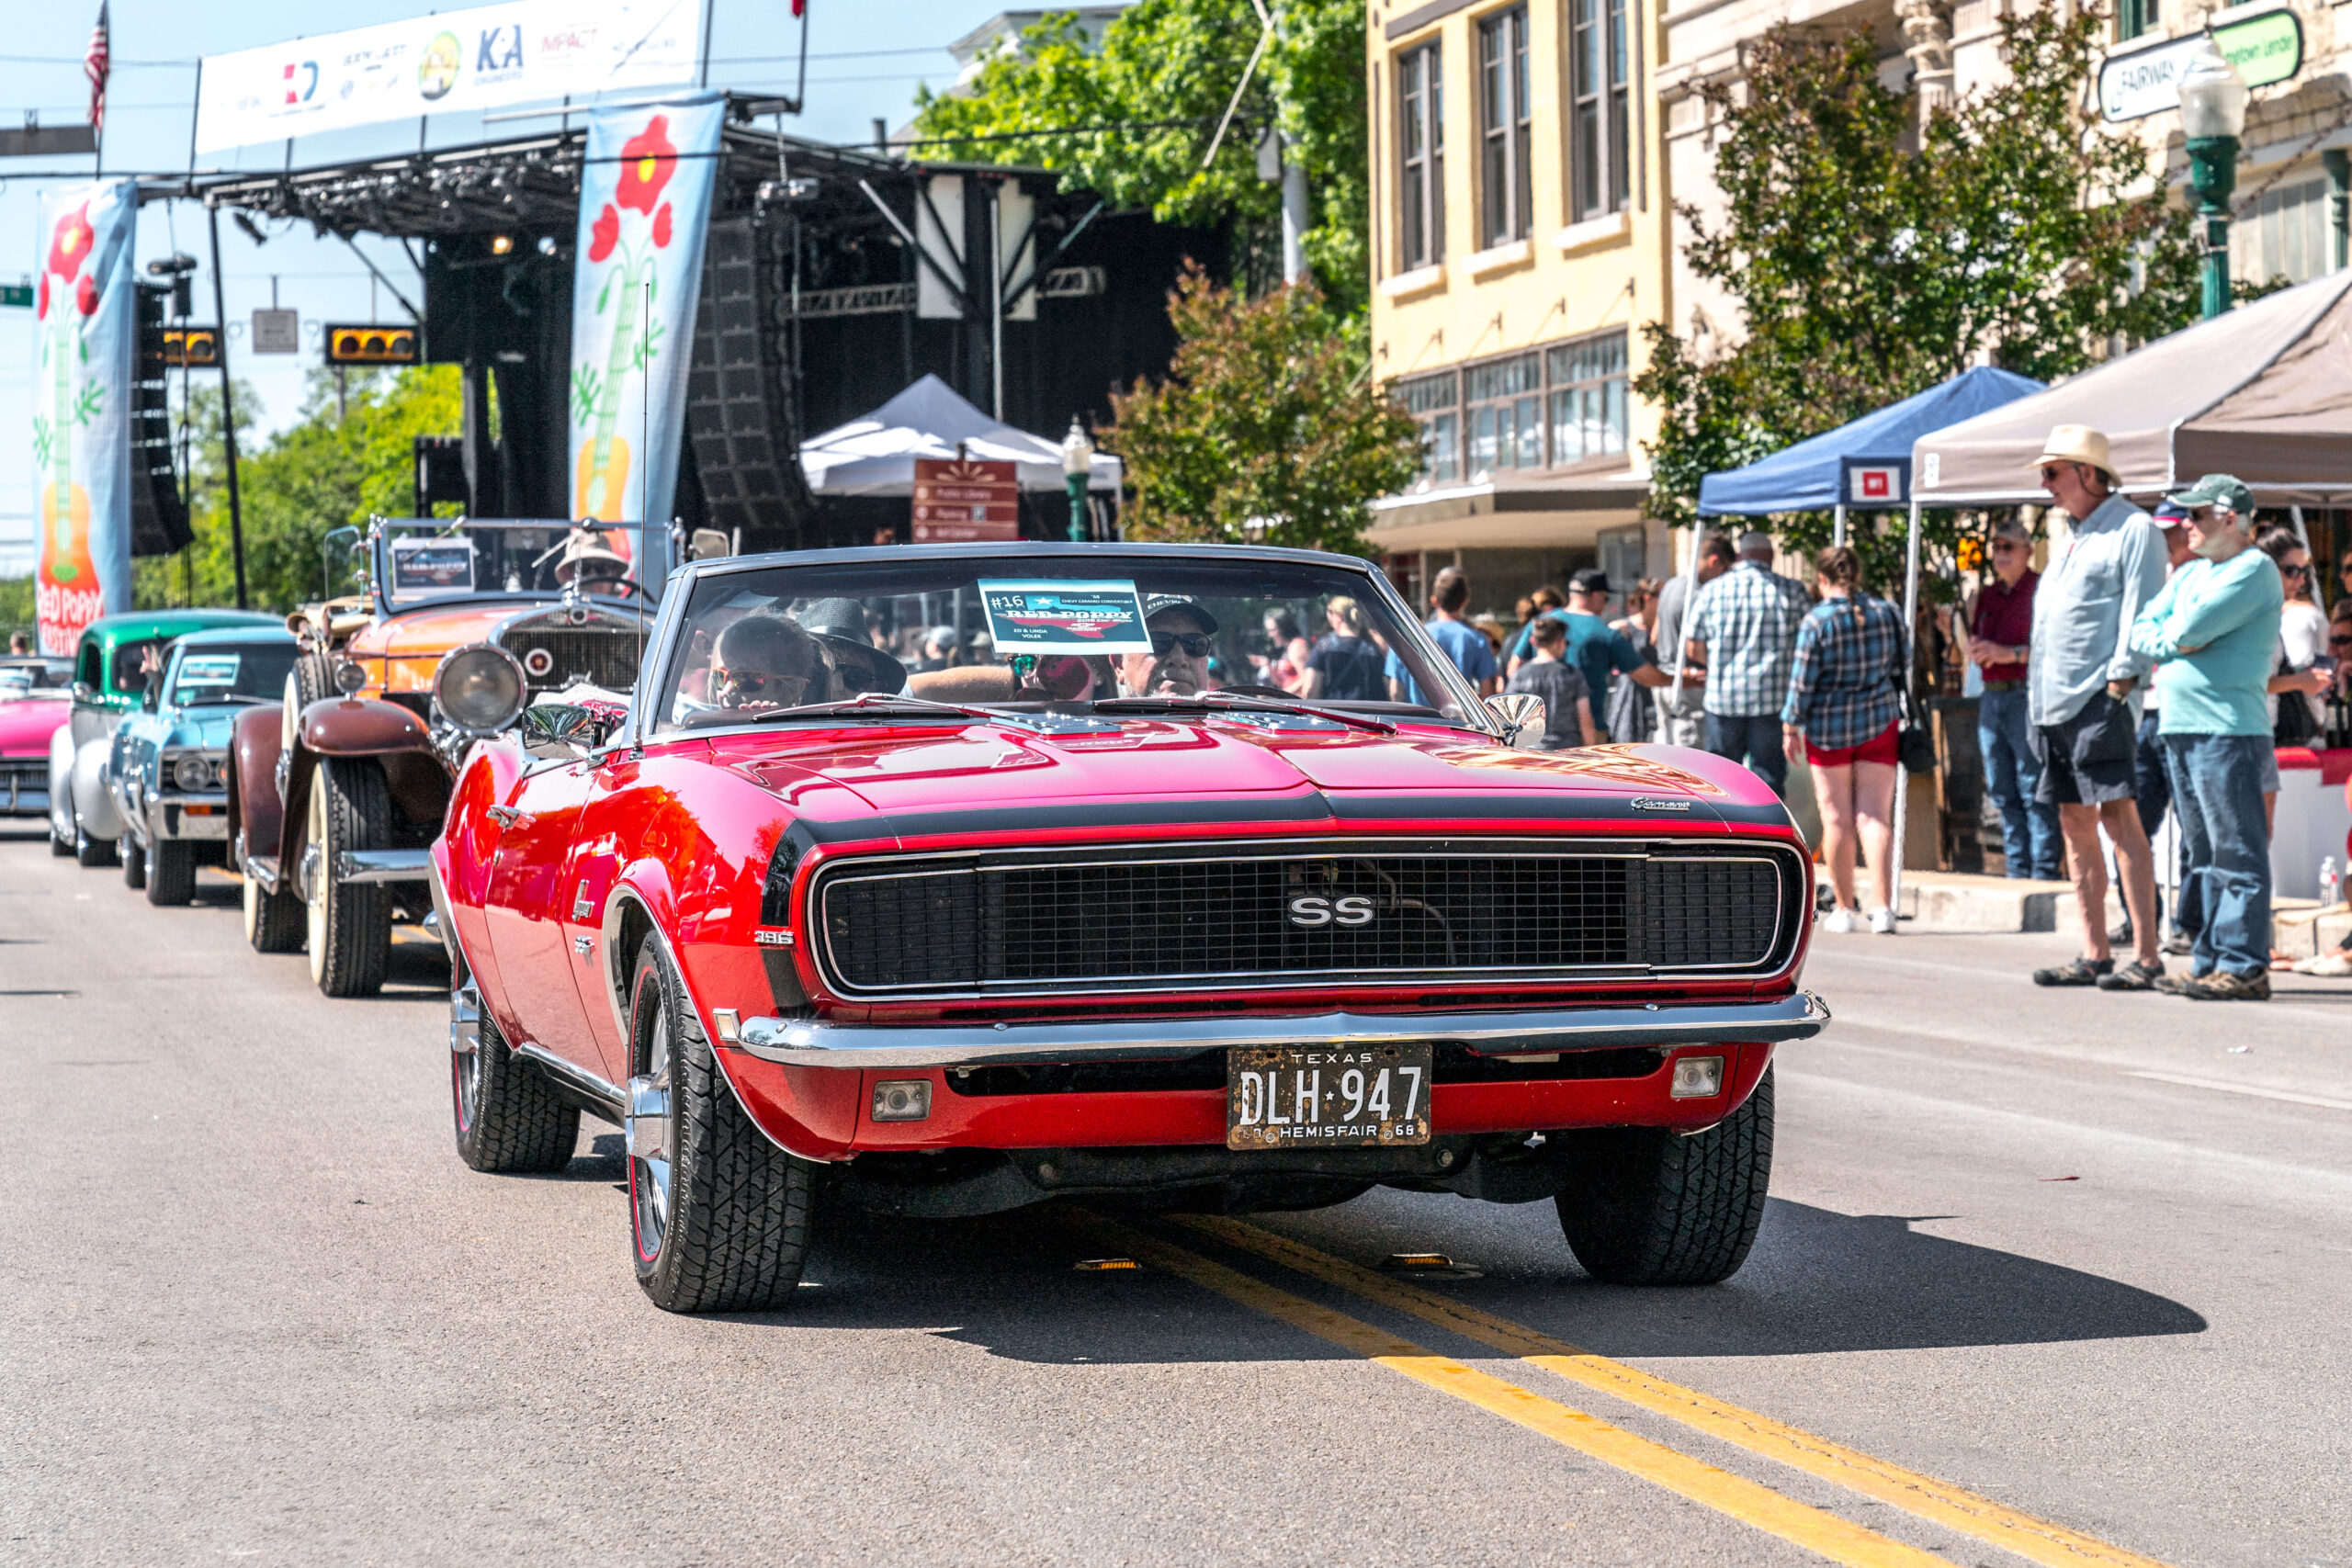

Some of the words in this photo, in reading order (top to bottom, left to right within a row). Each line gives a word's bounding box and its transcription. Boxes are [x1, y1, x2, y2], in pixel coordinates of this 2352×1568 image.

[37, 581, 61, 623] RED
[62, 586, 105, 625] POPPY
[990, 595, 1024, 609] #16
[1004, 610, 1053, 618] RED
[1059, 611, 1134, 619] POPPY
[1630, 796, 1690, 811] Camaro
[1291, 897, 1374, 925] SS
[753, 931, 794, 944] 396
[1291, 1053, 1372, 1064] TEXAS
[1280, 1124, 1377, 1138] HEMISFAIR
[1395, 1124, 1414, 1136] 68
